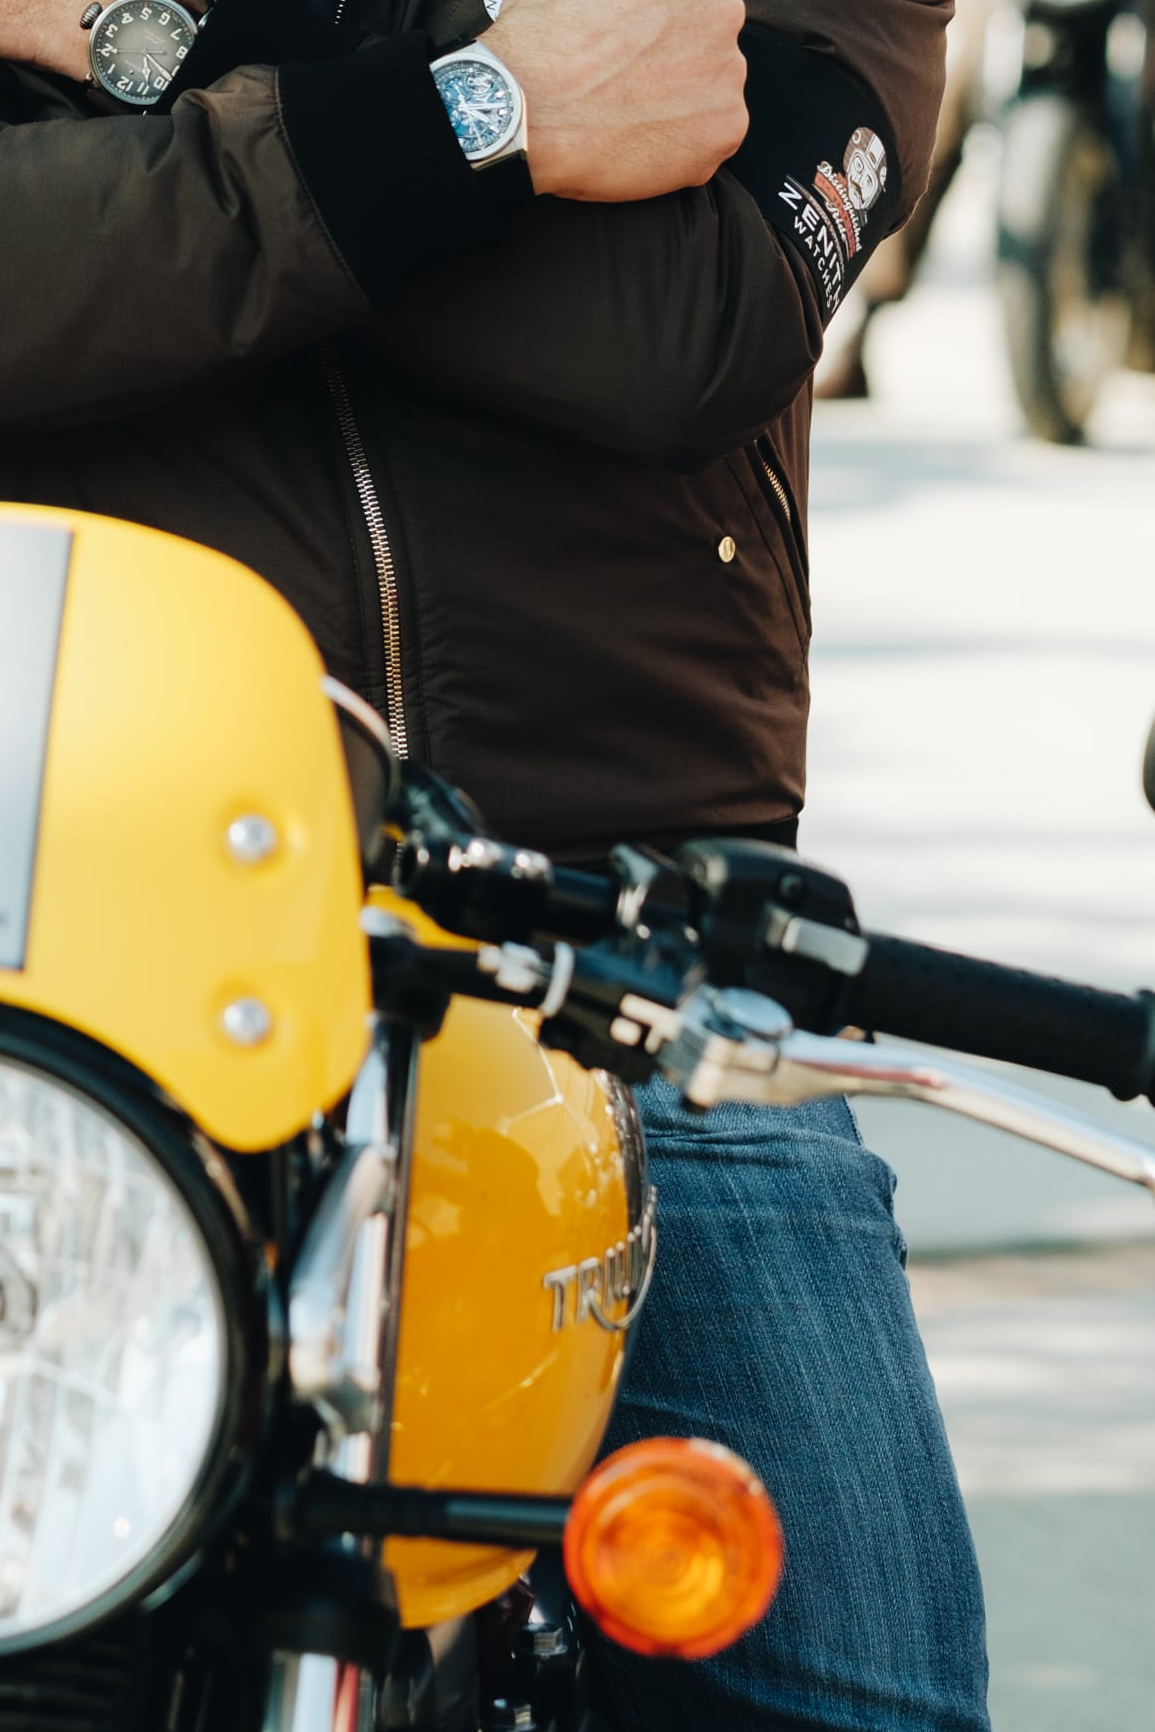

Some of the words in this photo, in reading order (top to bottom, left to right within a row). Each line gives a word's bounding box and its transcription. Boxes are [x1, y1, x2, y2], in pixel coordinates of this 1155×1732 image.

[116, 76, 133, 91] 12
[778, 182, 841, 314] ZENITH
[794, 215, 833, 309] WATCHES
